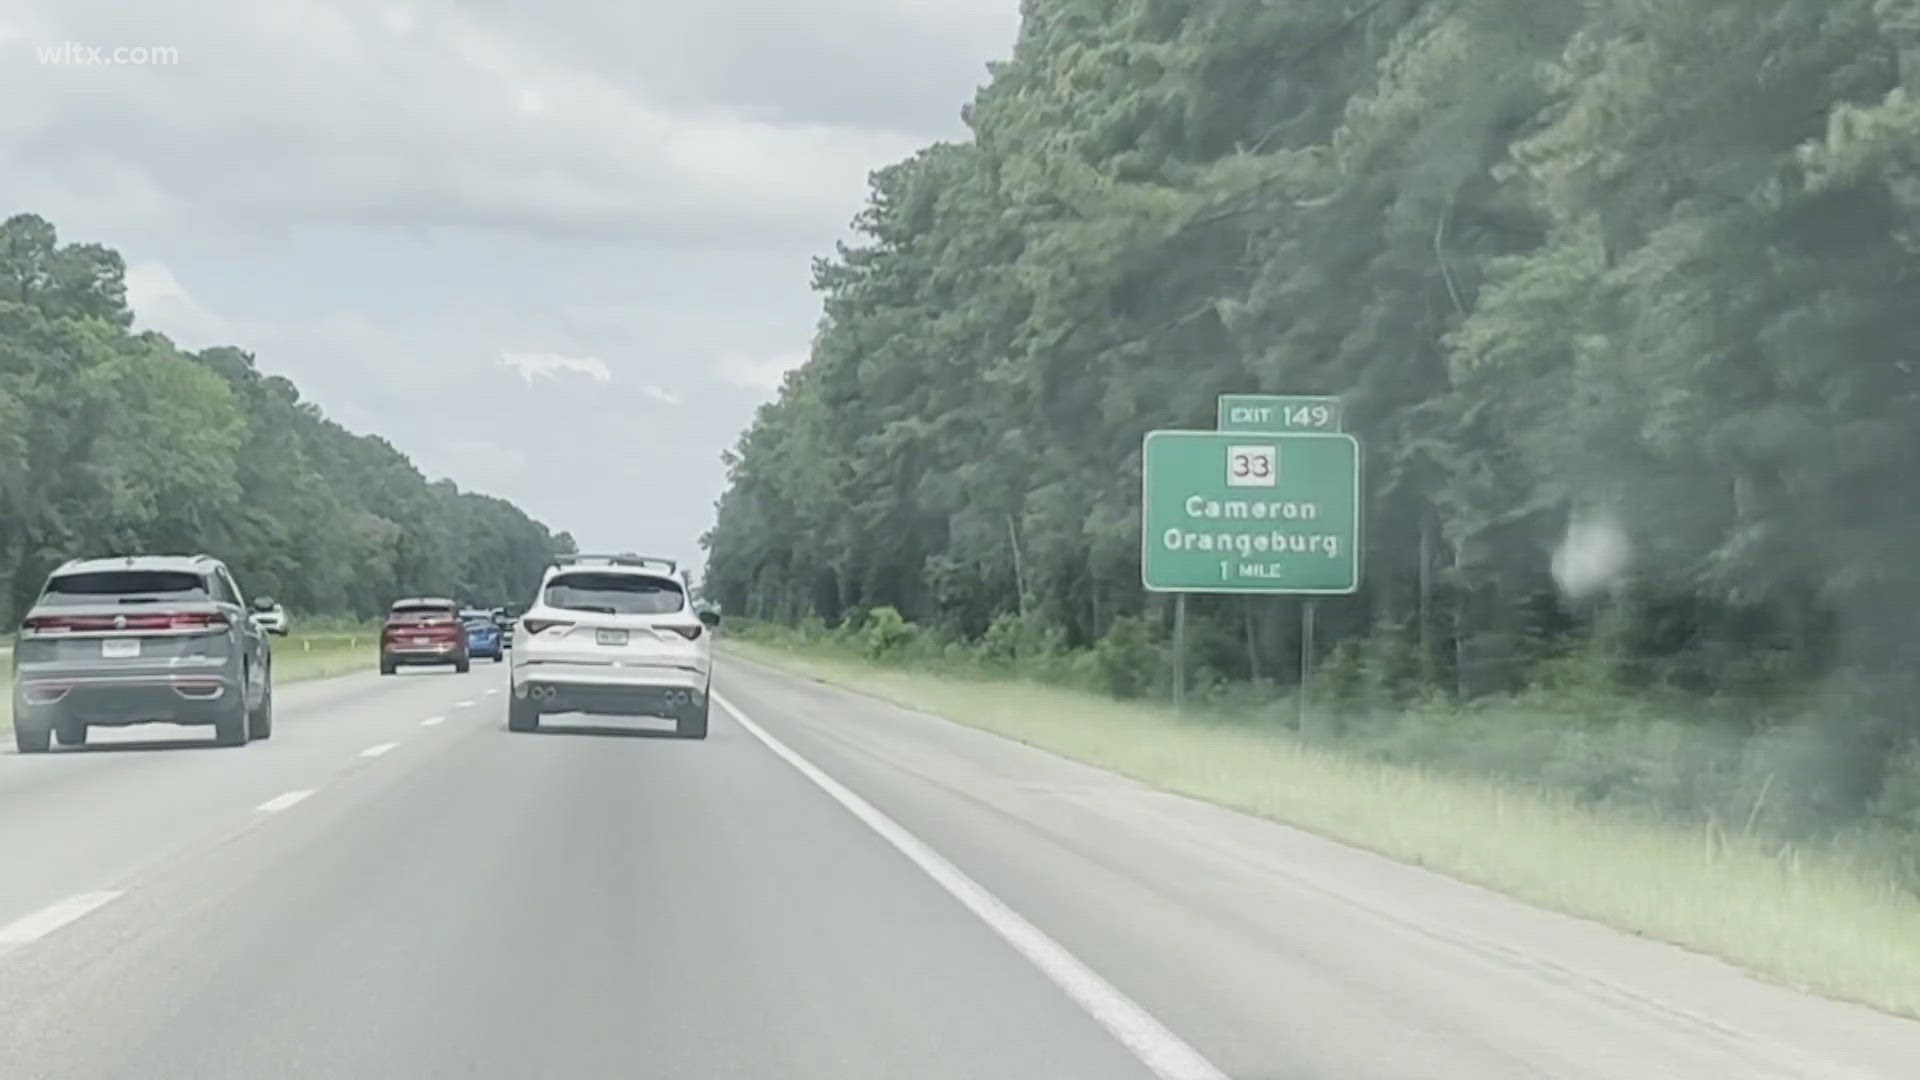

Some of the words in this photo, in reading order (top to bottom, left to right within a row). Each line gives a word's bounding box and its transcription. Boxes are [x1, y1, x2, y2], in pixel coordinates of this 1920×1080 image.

[1230, 407, 1271, 423] EXIT
[1283, 406, 1329, 426] 149
[1232, 454, 1271, 478] 33
[1185, 495, 1317, 520] Cameron
[1163, 528, 1339, 559] Orangeburg
[1219, 560, 1229, 581] 1
[1238, 563, 1282, 579] MILE
